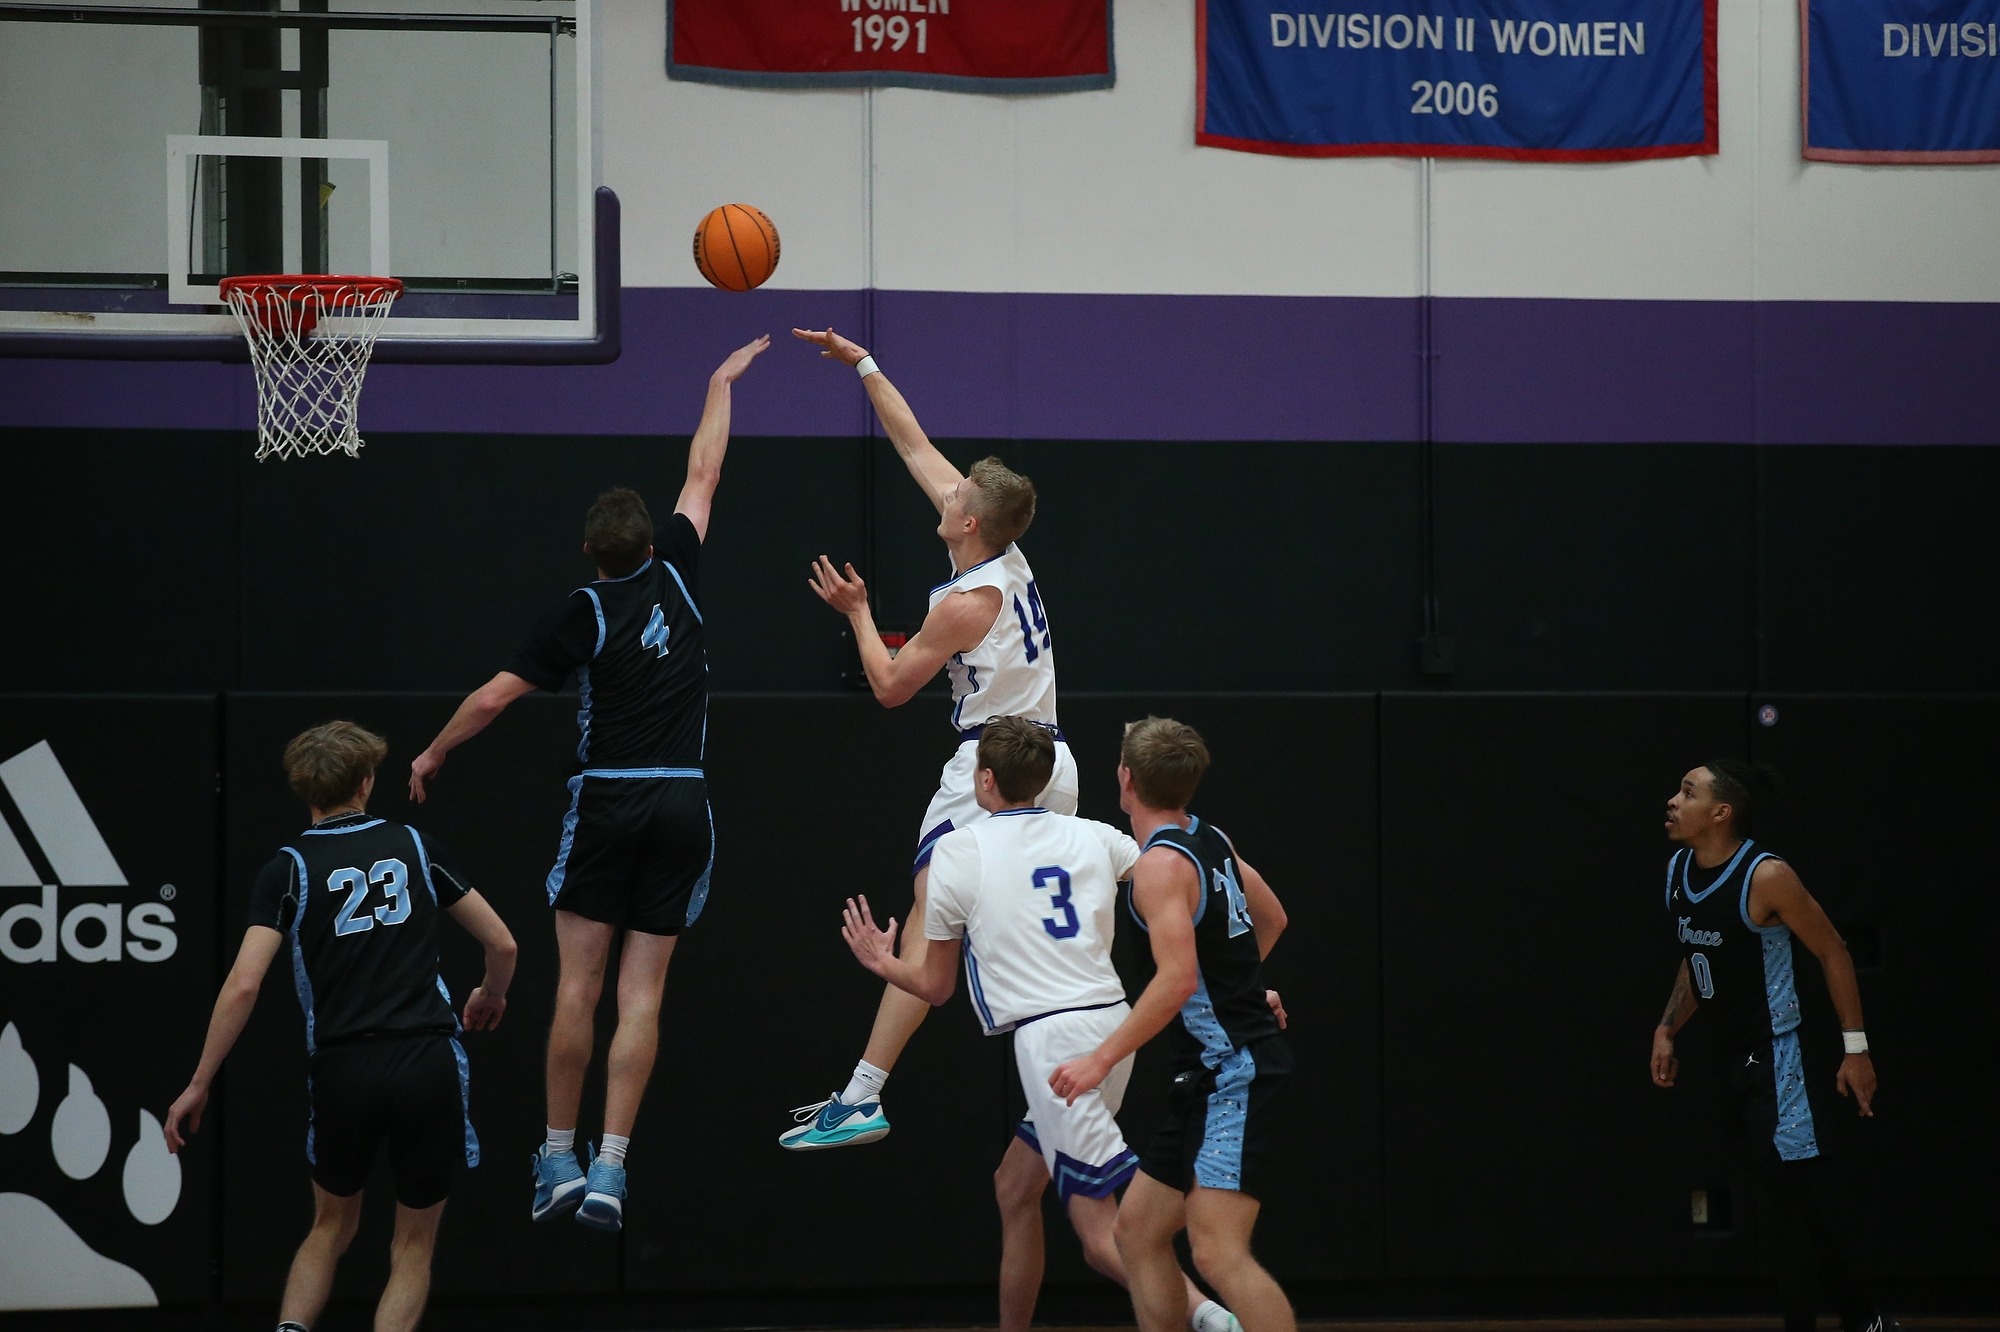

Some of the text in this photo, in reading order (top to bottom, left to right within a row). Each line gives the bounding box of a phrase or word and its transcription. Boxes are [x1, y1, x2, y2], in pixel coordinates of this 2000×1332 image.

[851, 14, 927, 53] 1991
[1270, 13, 1645, 56] DIVISION II WOMEN
[1410, 80, 1499, 118] 2006
[641, 603, 670, 658] 4
[1013, 580, 1050, 665] 14
[327, 858, 411, 937] 23
[1032, 865, 1080, 940] 3
[1691, 953, 1714, 999] 0
